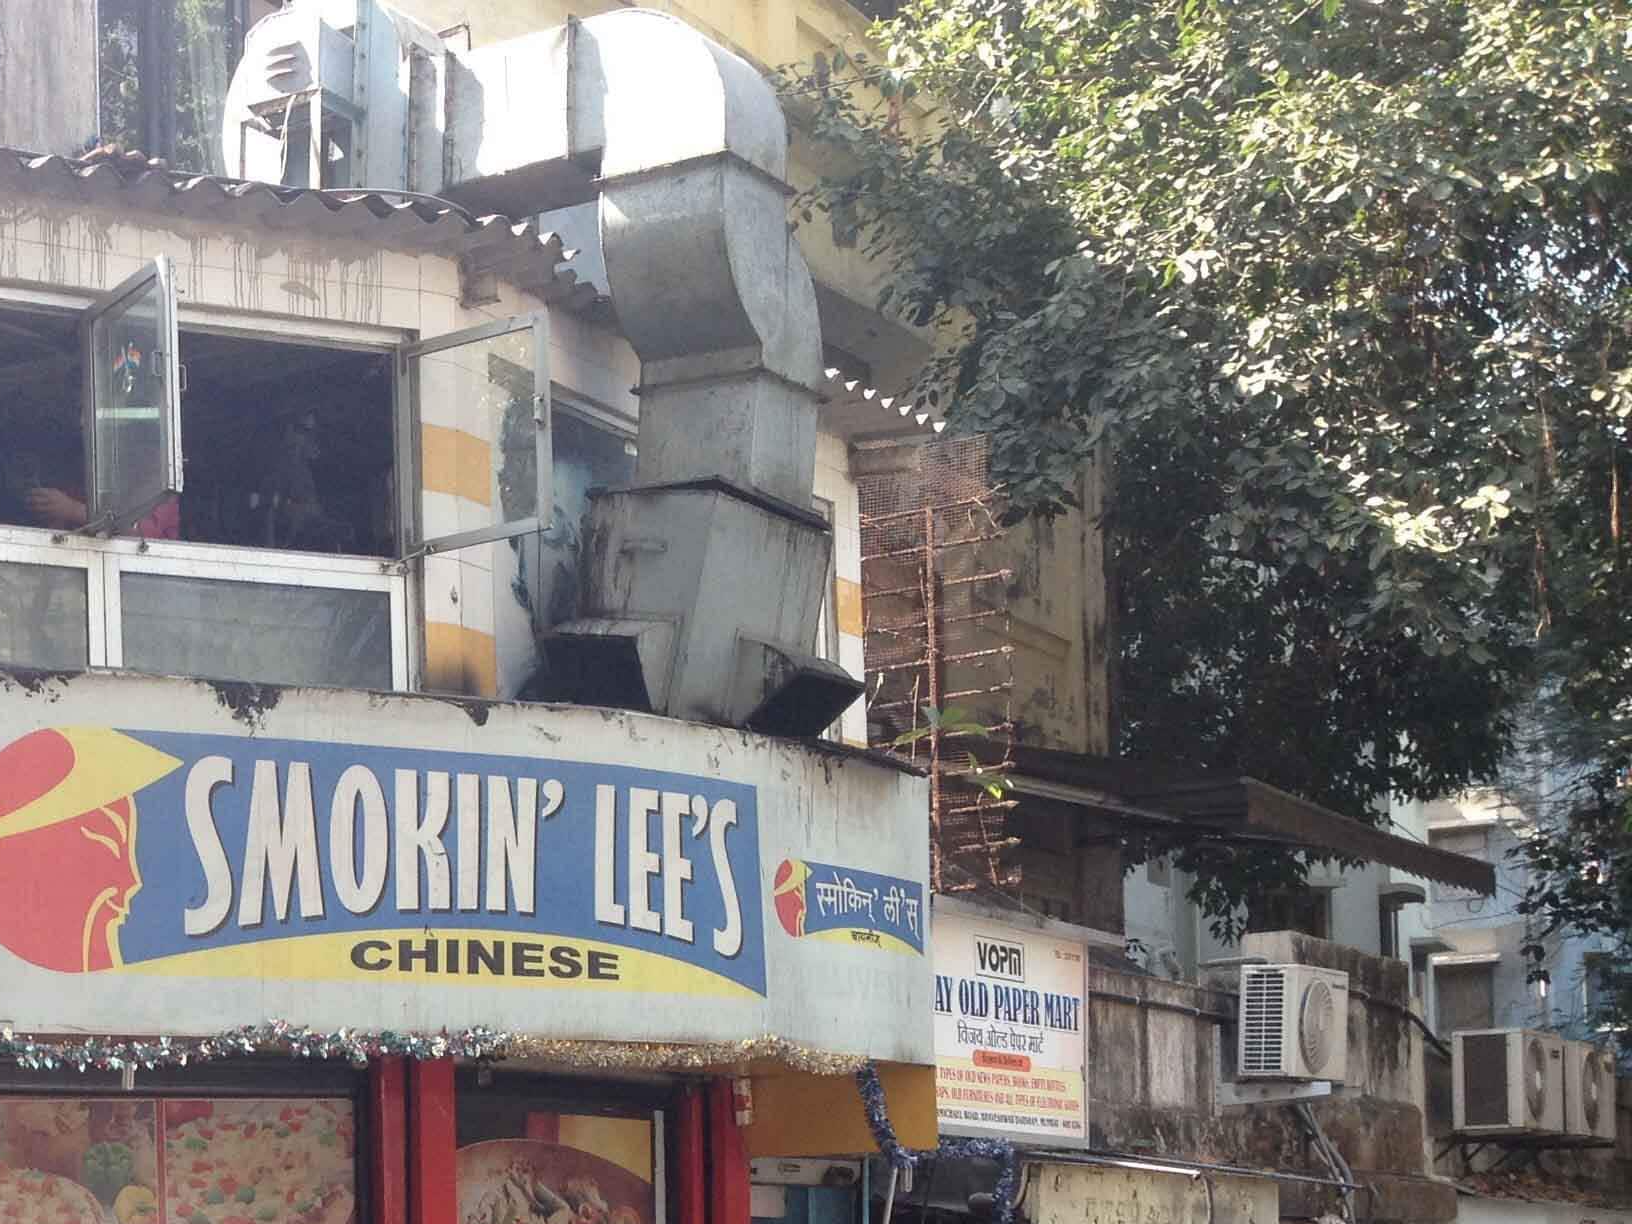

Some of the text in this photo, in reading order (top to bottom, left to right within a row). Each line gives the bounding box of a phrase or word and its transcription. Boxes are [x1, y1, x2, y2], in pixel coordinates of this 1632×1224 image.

[183, 754, 745, 959] SMOKIN' LEE'S
[350, 938, 620, 982] CHINESE
[958, 978, 988, 1018] OLD
[993, 983, 1040, 1026] PAPER
[1043, 992, 1080, 1031] MART
